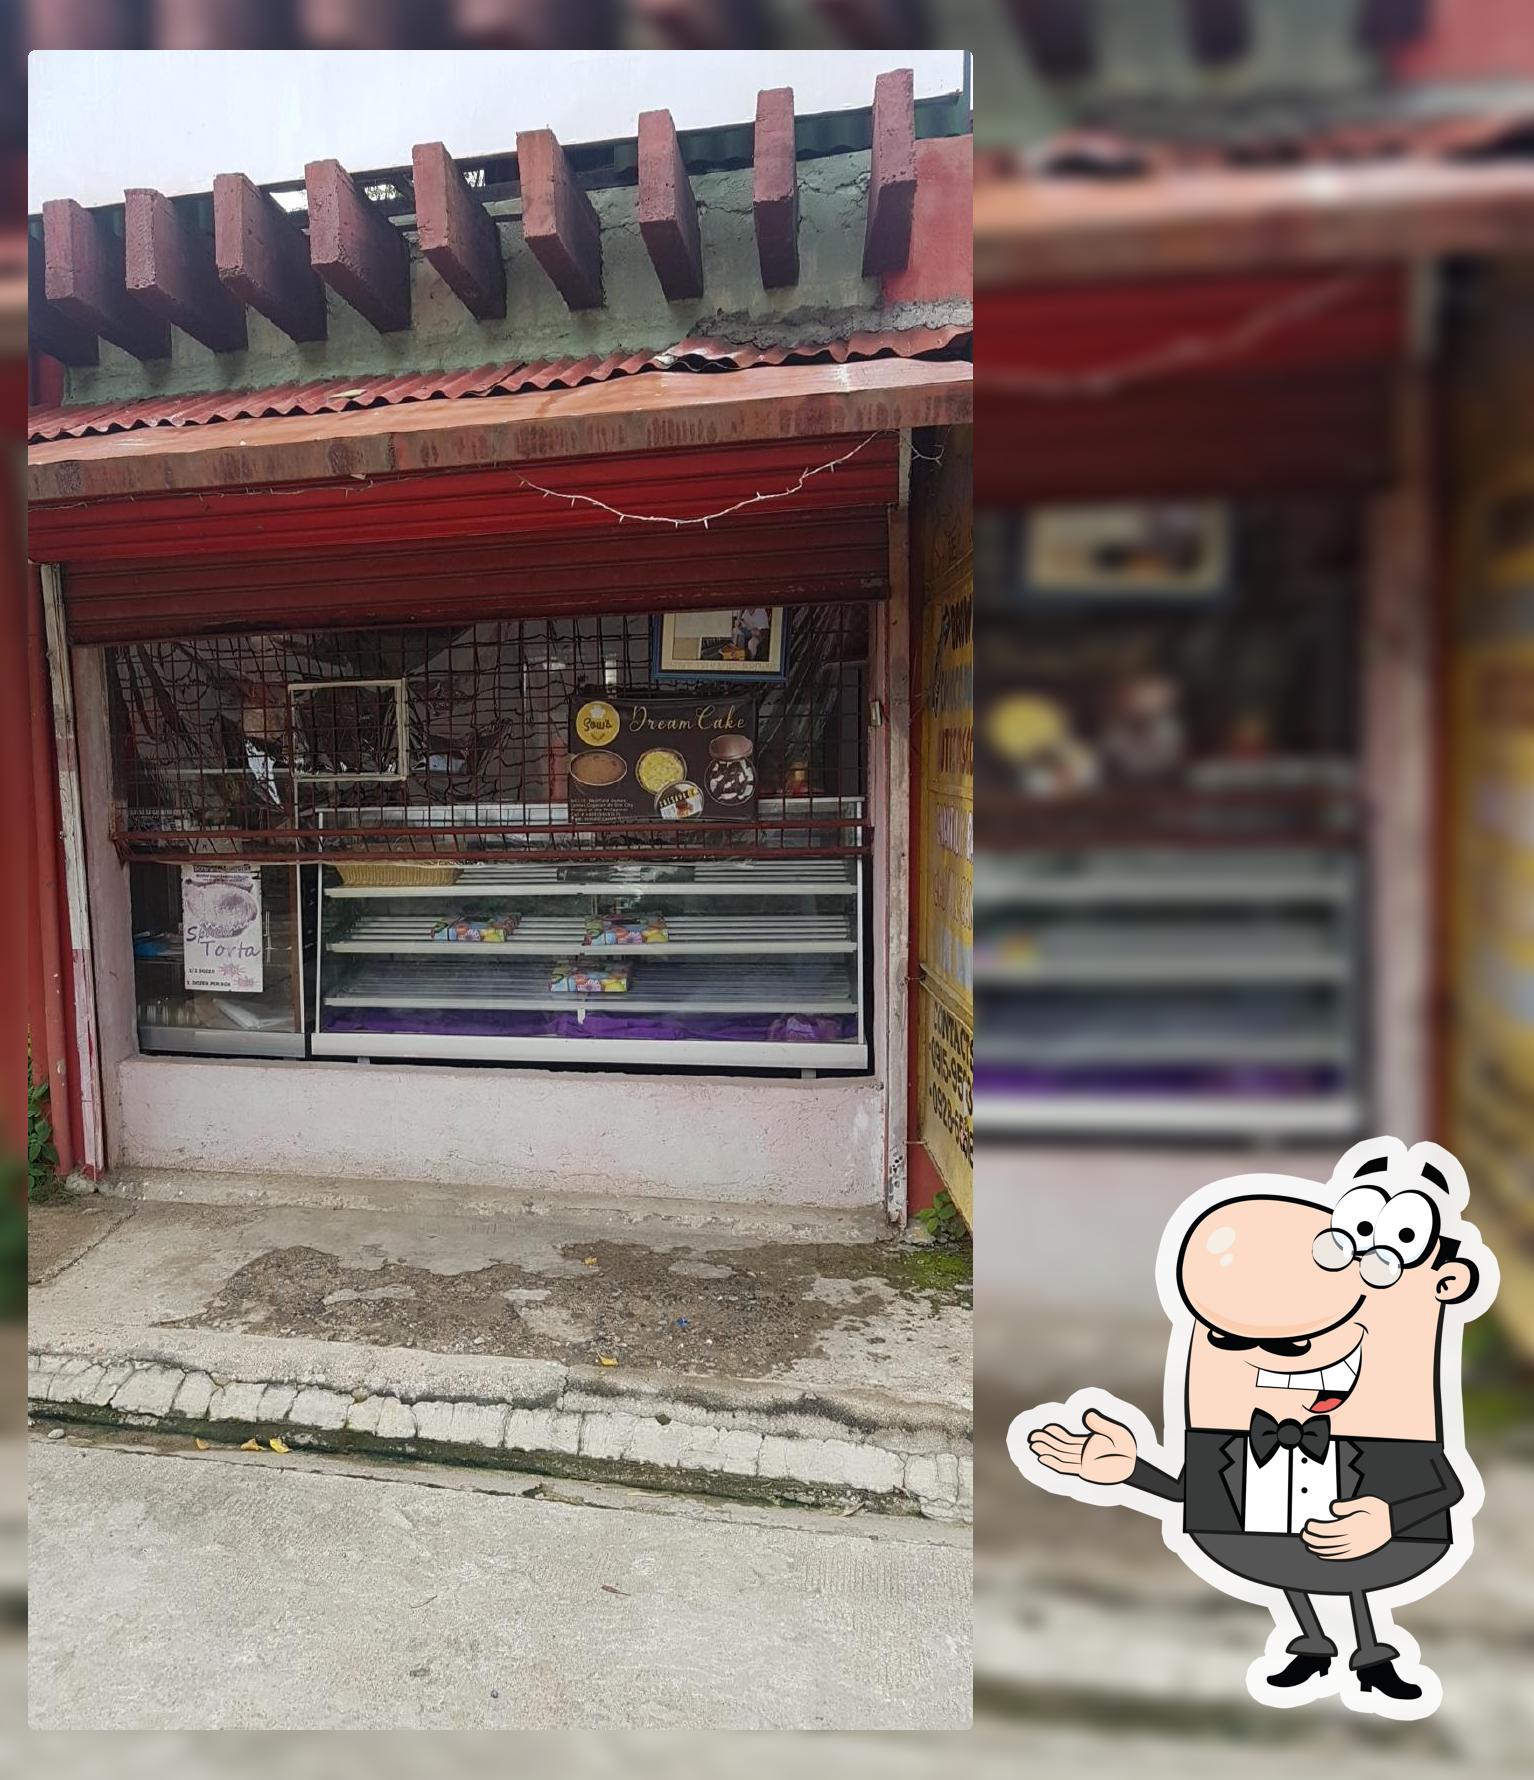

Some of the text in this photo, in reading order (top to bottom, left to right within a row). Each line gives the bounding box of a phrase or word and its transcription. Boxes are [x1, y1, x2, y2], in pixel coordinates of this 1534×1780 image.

[629, 705, 746, 732] Dream Cake
[200, 941, 261, 959] Torta
